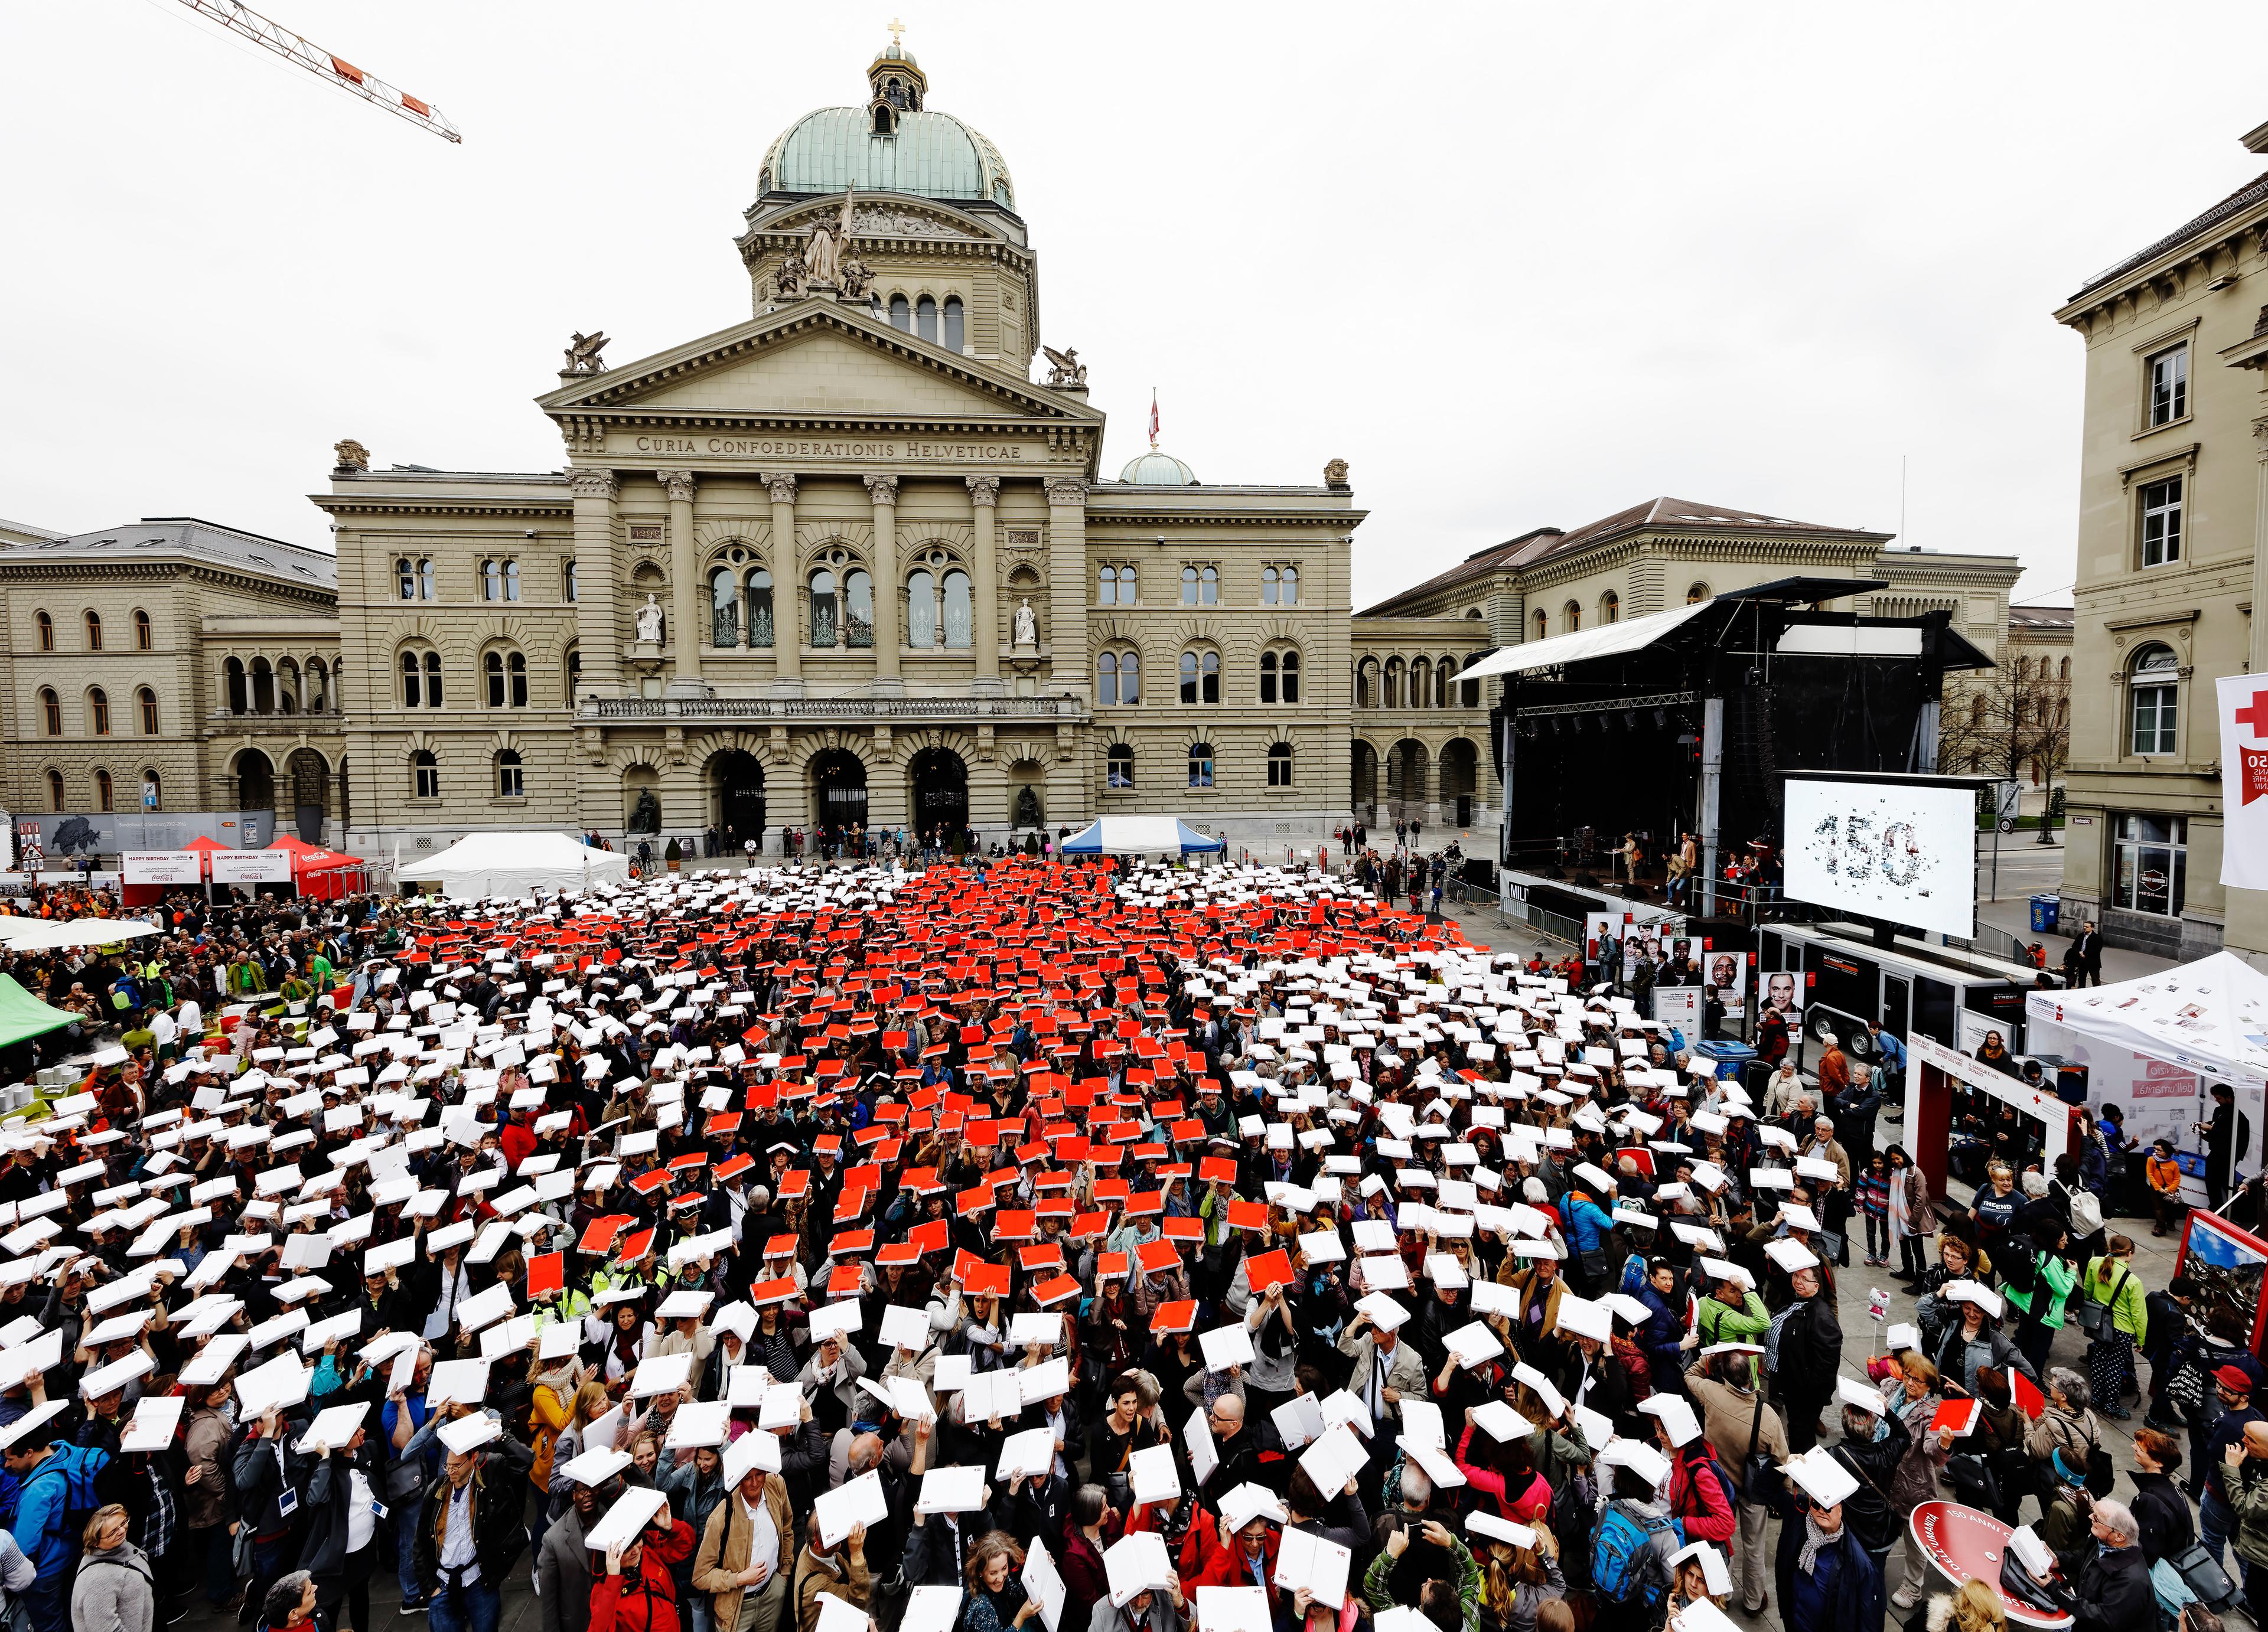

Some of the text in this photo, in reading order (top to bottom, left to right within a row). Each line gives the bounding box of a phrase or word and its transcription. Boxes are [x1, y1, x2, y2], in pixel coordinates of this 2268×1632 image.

[636, 436, 1020, 458] CURIA CONFOEDERATIONIS HELVETICAE
[1815, 815, 1920, 887] 150
[1910, 1035, 1921, 1043] SPENDE
[1935, 1047, 1948, 1056] DONNER
[1935, 1051, 1947, 1060] SAUVER
[1969, 1067, 1983, 1077] DONALO
[1973, 1065, 1987, 1075] SANGUE
[1947, 1510, 2000, 1532] 150 ANNI
